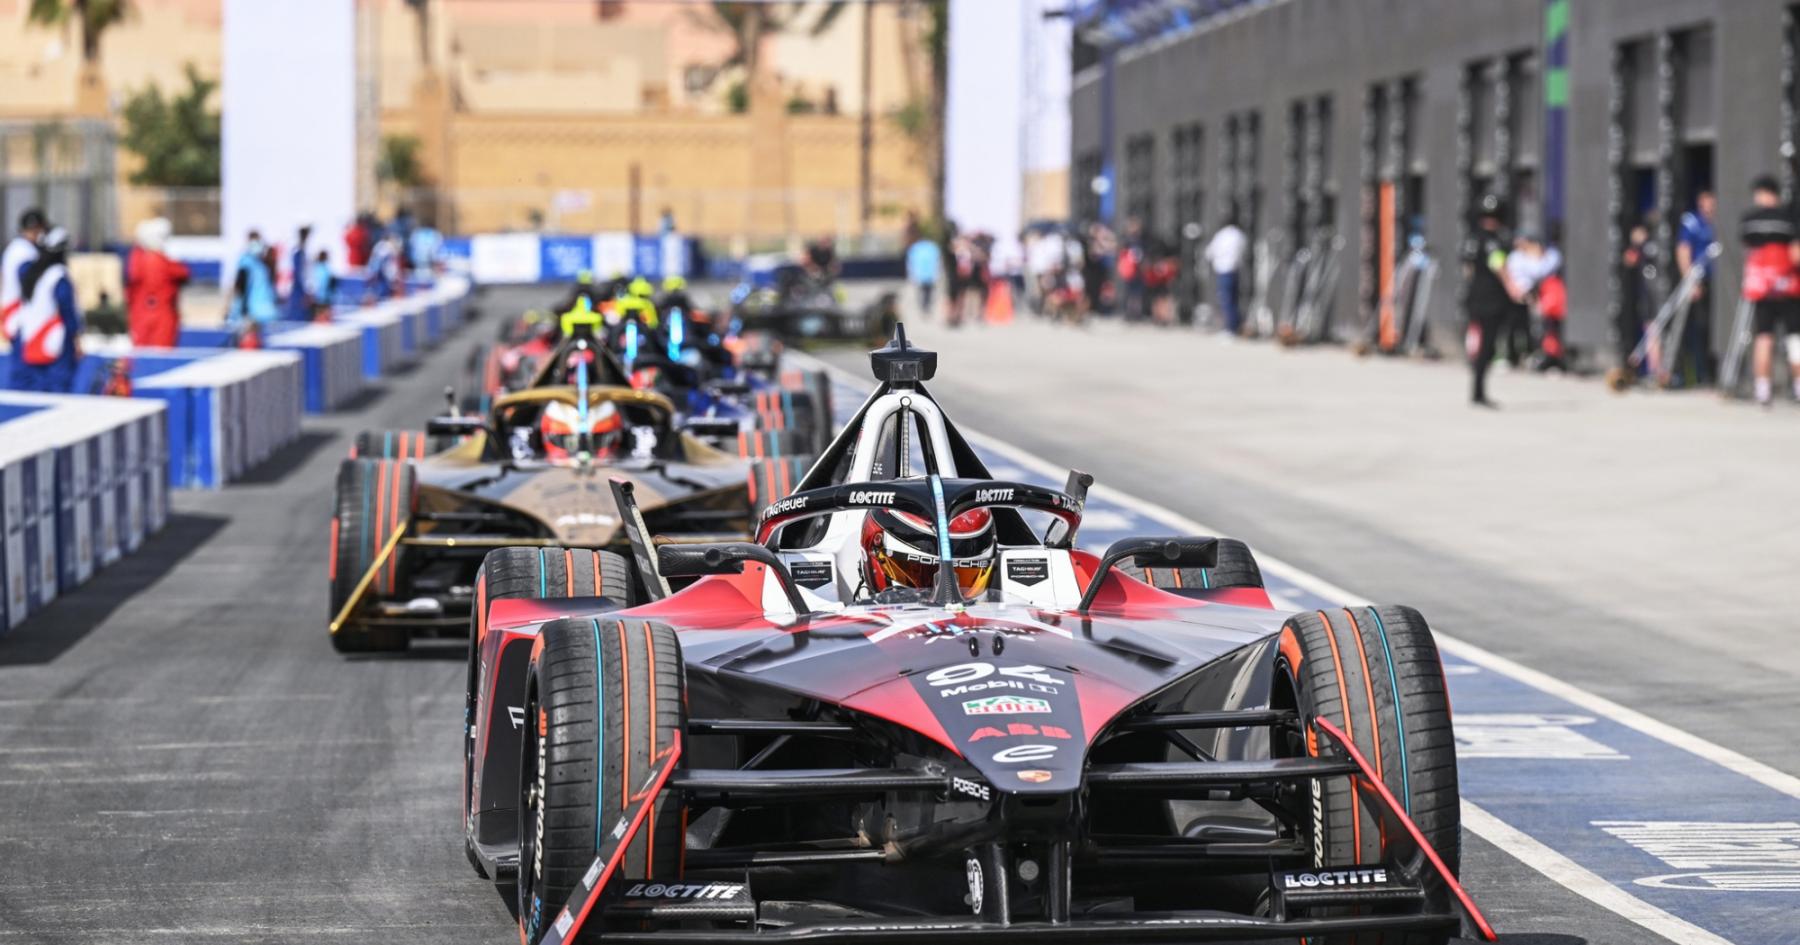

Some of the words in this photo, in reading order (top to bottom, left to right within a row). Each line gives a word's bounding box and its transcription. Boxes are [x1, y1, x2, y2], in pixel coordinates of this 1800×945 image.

[848, 491, 896, 504] LOCTITE
[975, 488, 1014, 502] LOCTITE
[926, 662, 1065, 686] 94
[940, 680, 1025, 698] Mobil
[968, 722, 1072, 742] ABB
[953, 776, 990, 801] PORSCHE
[1284, 869, 1387, 888] LOCTITE
[625, 884, 745, 899] LOCTITE
